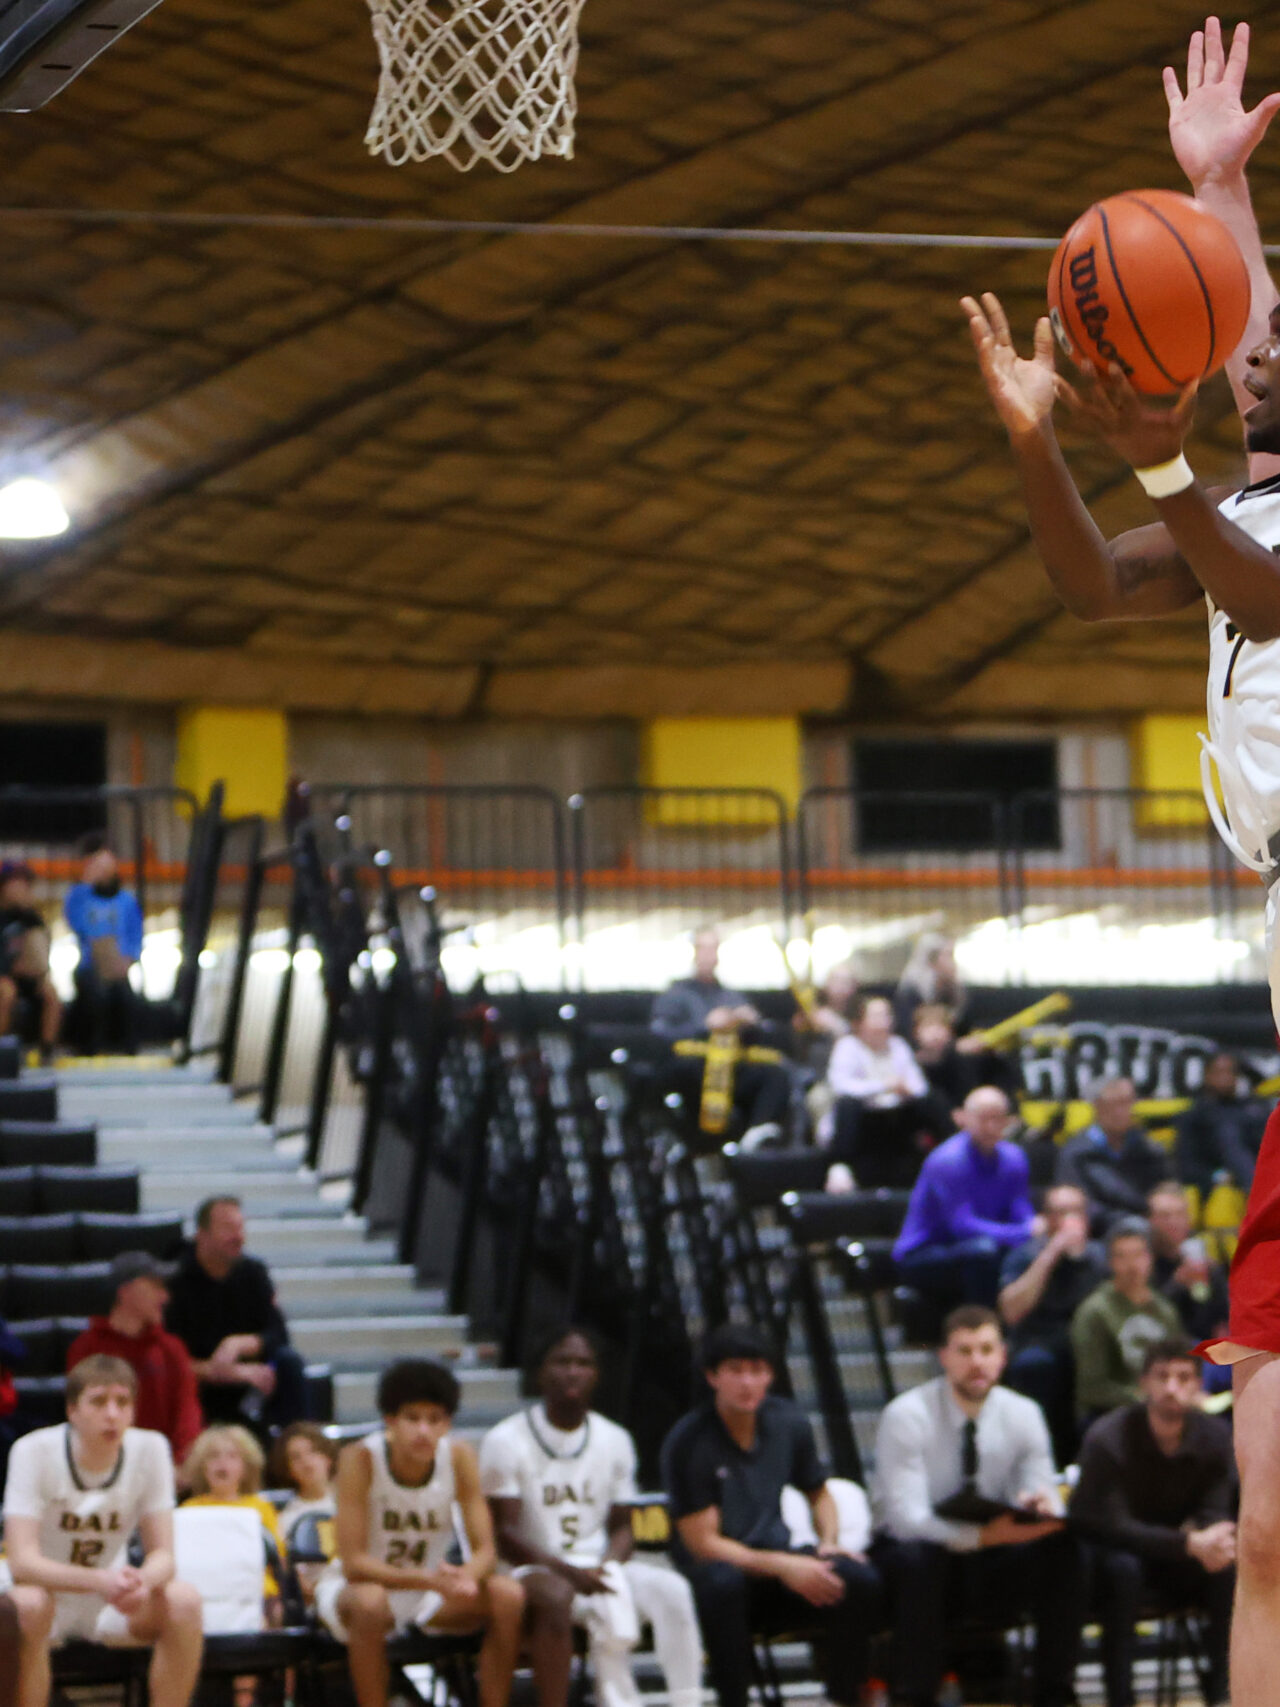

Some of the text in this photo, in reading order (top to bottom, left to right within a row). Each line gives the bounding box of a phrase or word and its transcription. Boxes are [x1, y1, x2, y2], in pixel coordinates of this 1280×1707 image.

[542, 1481, 595, 1506] DAL
[59, 1511, 121, 1532] DAL
[381, 1510, 440, 1531] DAL
[560, 1514, 579, 1550] 5
[70, 1538, 105, 1566] 12
[386, 1539, 428, 1566] 24
